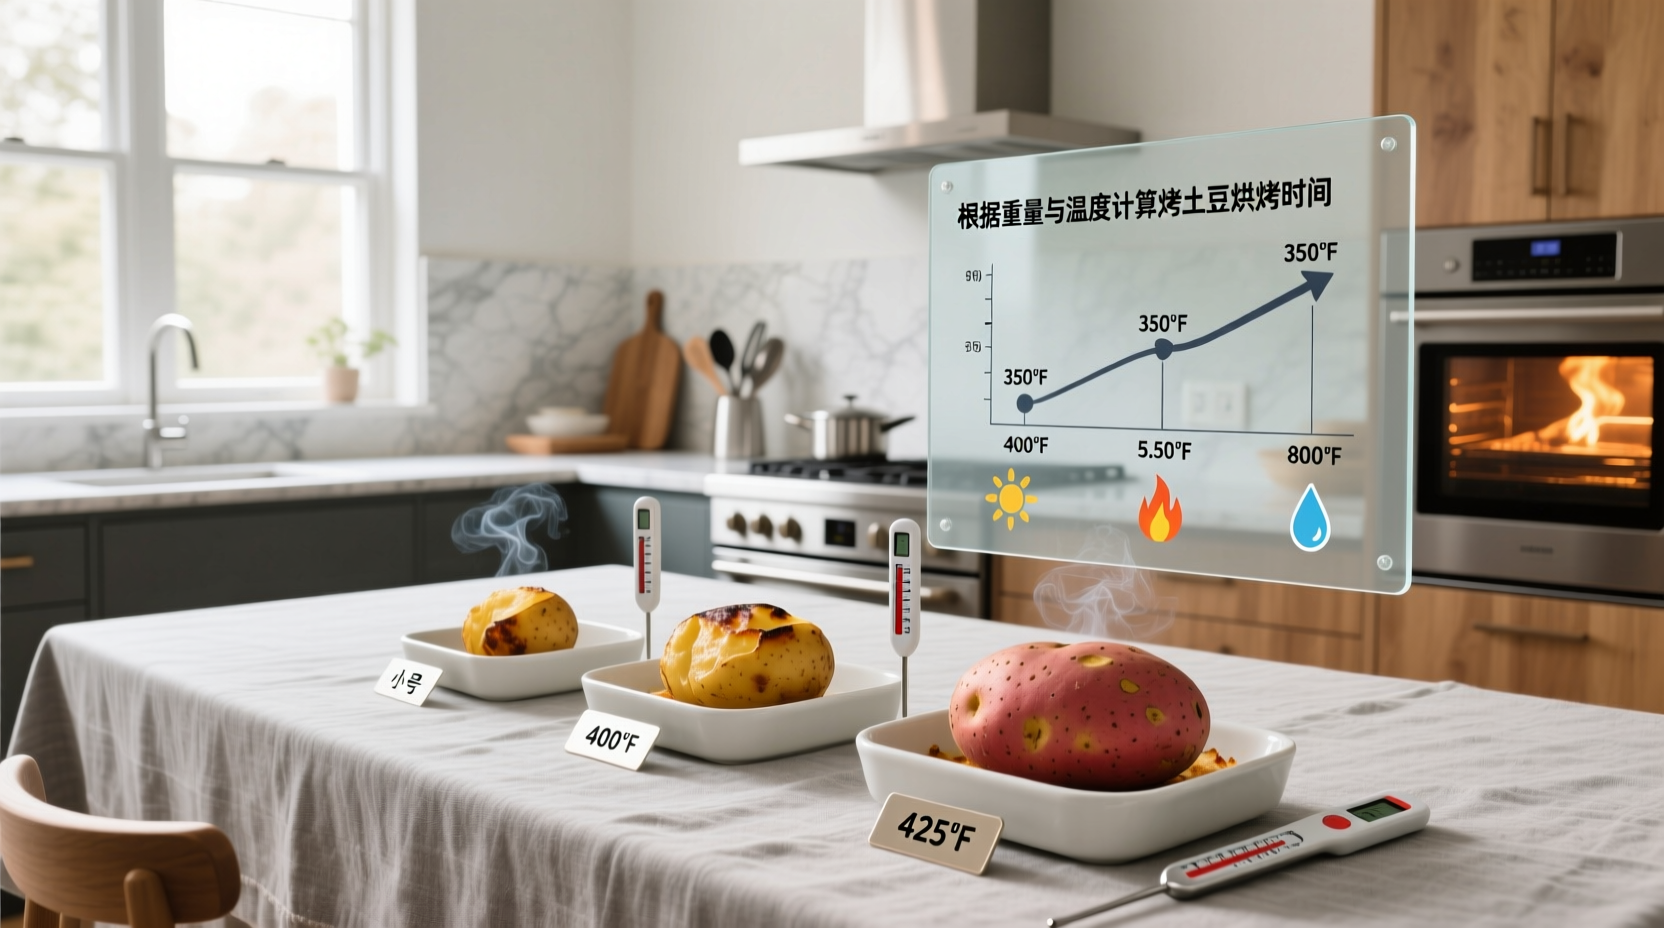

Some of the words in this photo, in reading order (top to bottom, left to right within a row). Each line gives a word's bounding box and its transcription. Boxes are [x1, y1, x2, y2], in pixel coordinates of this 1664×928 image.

[957, 176, 1332, 230] 根据重量与温度计算烤土豆烘烤时间
